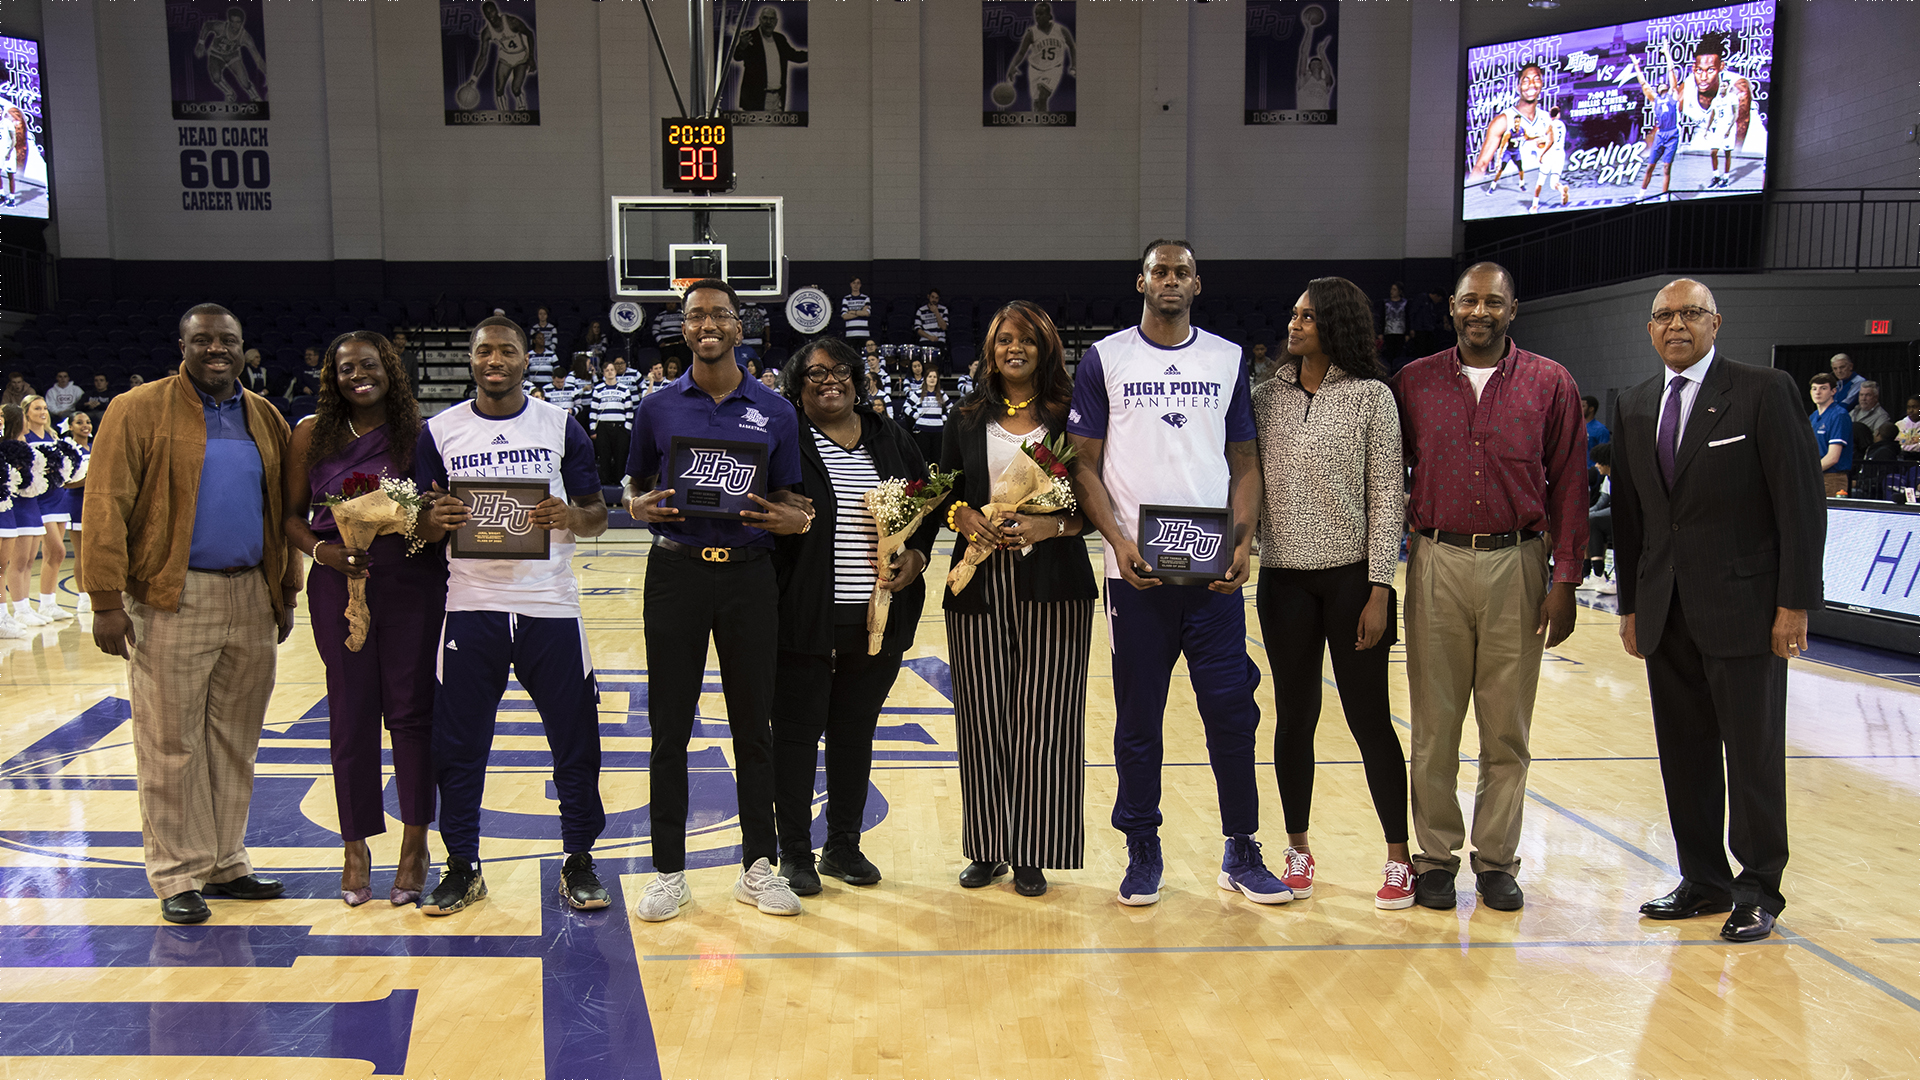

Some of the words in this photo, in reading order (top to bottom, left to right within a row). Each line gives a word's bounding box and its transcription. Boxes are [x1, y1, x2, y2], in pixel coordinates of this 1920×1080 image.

[1041, 47, 1057, 60] 15
[1471, 38, 1562, 84] WRIGHT
[1597, 65, 1615, 81] VS
[182, 103, 258, 114] 1969-1973
[1627, 101, 1637, 110] 27
[455, 112, 530, 123] 1965-1969
[1253, 112, 1328, 123] 1956-1960
[178, 127, 217, 146] HEAD
[222, 127, 268, 146] COACH
[669, 125, 725, 144] 20:00
[679, 146, 717, 180] 30
[1568, 141, 1647, 171] SENIOR
[180, 149, 270, 189] 600
[1597, 162, 1642, 185] DAY
[182, 192, 233, 210] CAREER
[236, 192, 272, 210] WINS
[1871, 320, 1889, 334] EXIT
[1123, 382, 1165, 397] HIGH
[1170, 381, 1221, 397] POINT
[1123, 397, 1220, 410] PANTHERS
[739, 423, 767, 433] BASKETBALL
[450, 452, 492, 471] HIGH
[497, 448, 552, 465] POINT
[680, 447, 757, 496] HPU
[468, 489, 537, 536] HPU
[1146, 517, 1222, 562] HPU
